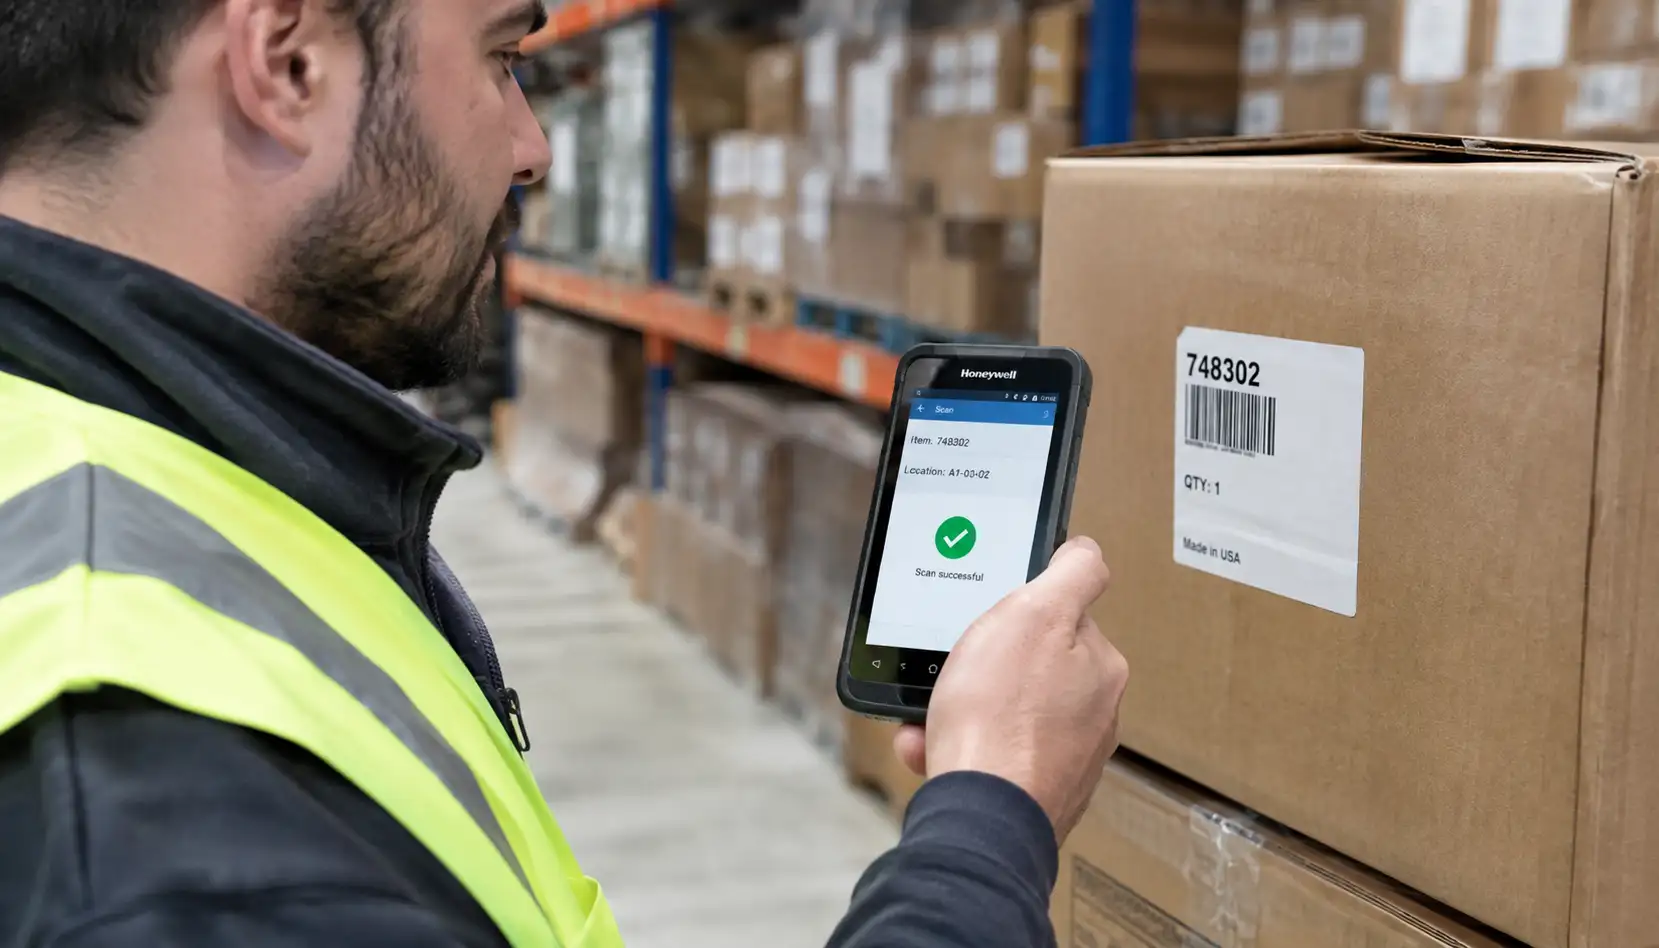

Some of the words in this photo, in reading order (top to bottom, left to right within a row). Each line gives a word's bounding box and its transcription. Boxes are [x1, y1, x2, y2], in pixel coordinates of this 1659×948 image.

[960, 368, 1017, 380] Honeywell
[1187, 352, 1260, 387] 748302
[935, 405, 954, 414] Scan
[937, 436, 970, 447] 748302
[904, 465, 945, 476] Location:
[1184, 474, 1211, 493] QTY:
[1214, 481, 1220, 495] 1
[1183, 537, 1208, 555] Made
[1209, 546, 1218, 558] in
[1220, 548, 1241, 565] USA
[915, 567, 936, 577] Scan
[938, 571, 984, 581] successful
